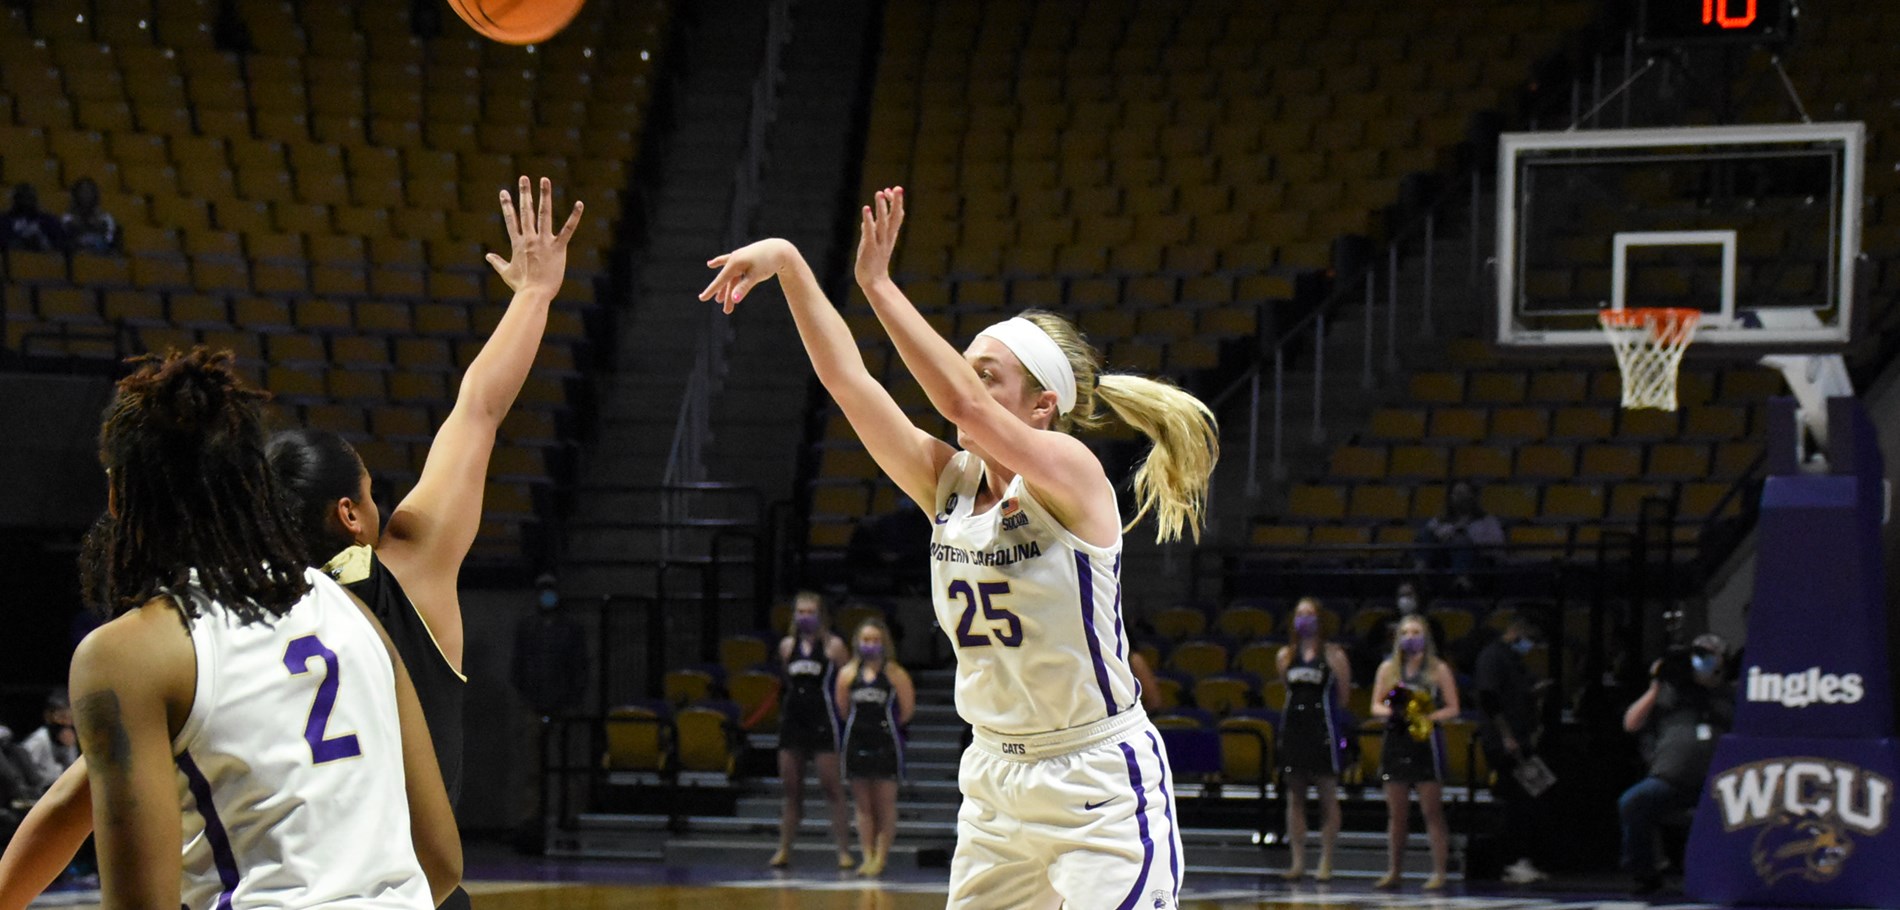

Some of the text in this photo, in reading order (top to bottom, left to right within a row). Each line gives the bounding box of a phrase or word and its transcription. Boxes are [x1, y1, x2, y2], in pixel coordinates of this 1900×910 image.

[970, 541, 1042, 566] CAROLINA
[948, 579, 1024, 648] 25
[282, 632, 362, 765] 2
[1746, 665, 1864, 707] ingles
[1001, 742, 1026, 755] CATS
[1716, 762, 1887, 831] WCU
